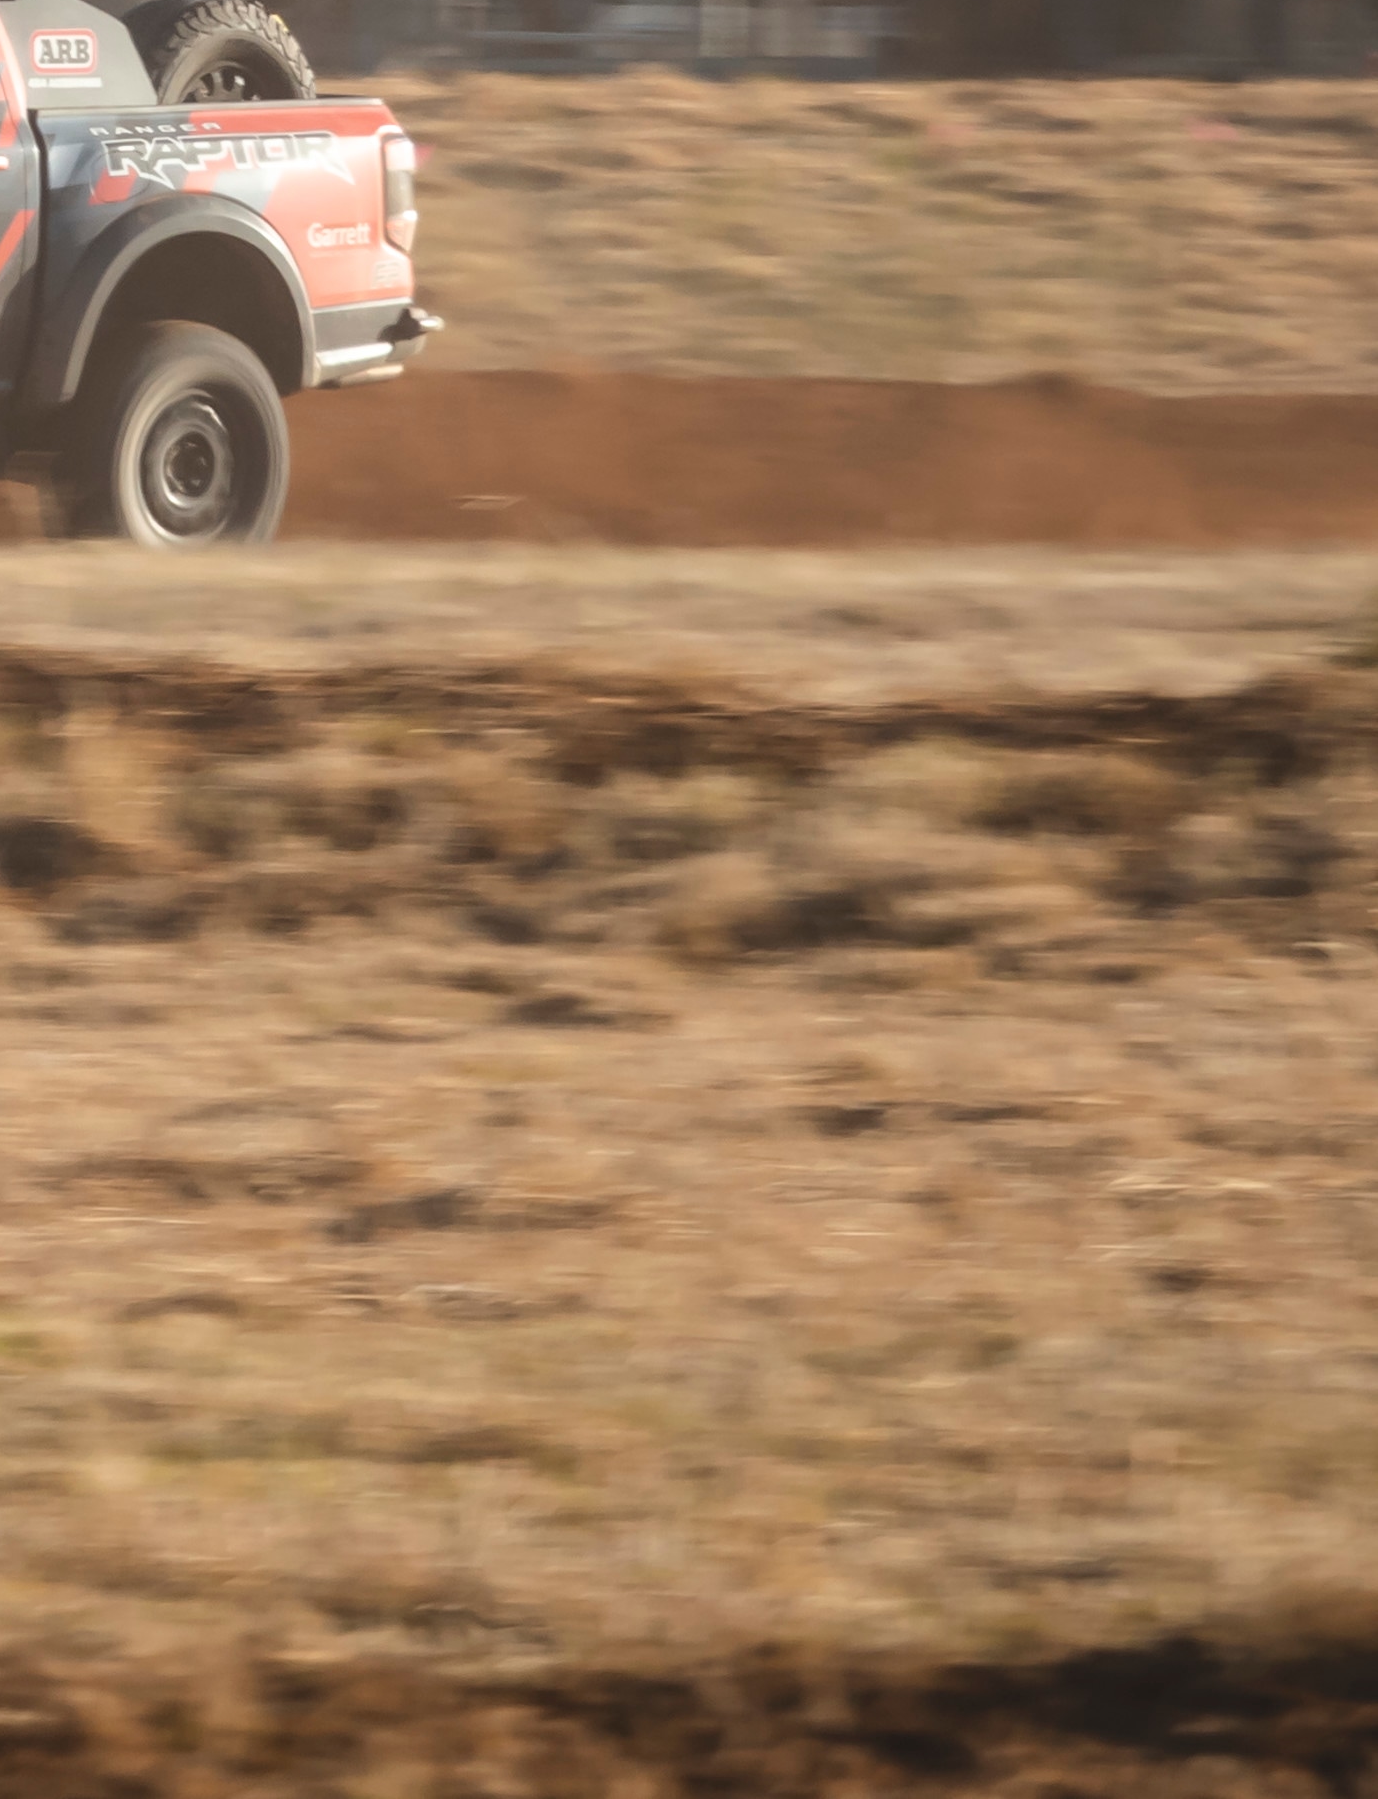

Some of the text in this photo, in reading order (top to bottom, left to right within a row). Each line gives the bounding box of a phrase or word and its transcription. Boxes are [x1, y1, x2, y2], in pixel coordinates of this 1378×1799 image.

[39, 39, 90, 64] ARB
[90, 122, 221, 136] RANGER
[101, 130, 355, 190] RAPTOR
[307, 223, 371, 248] Garrett
